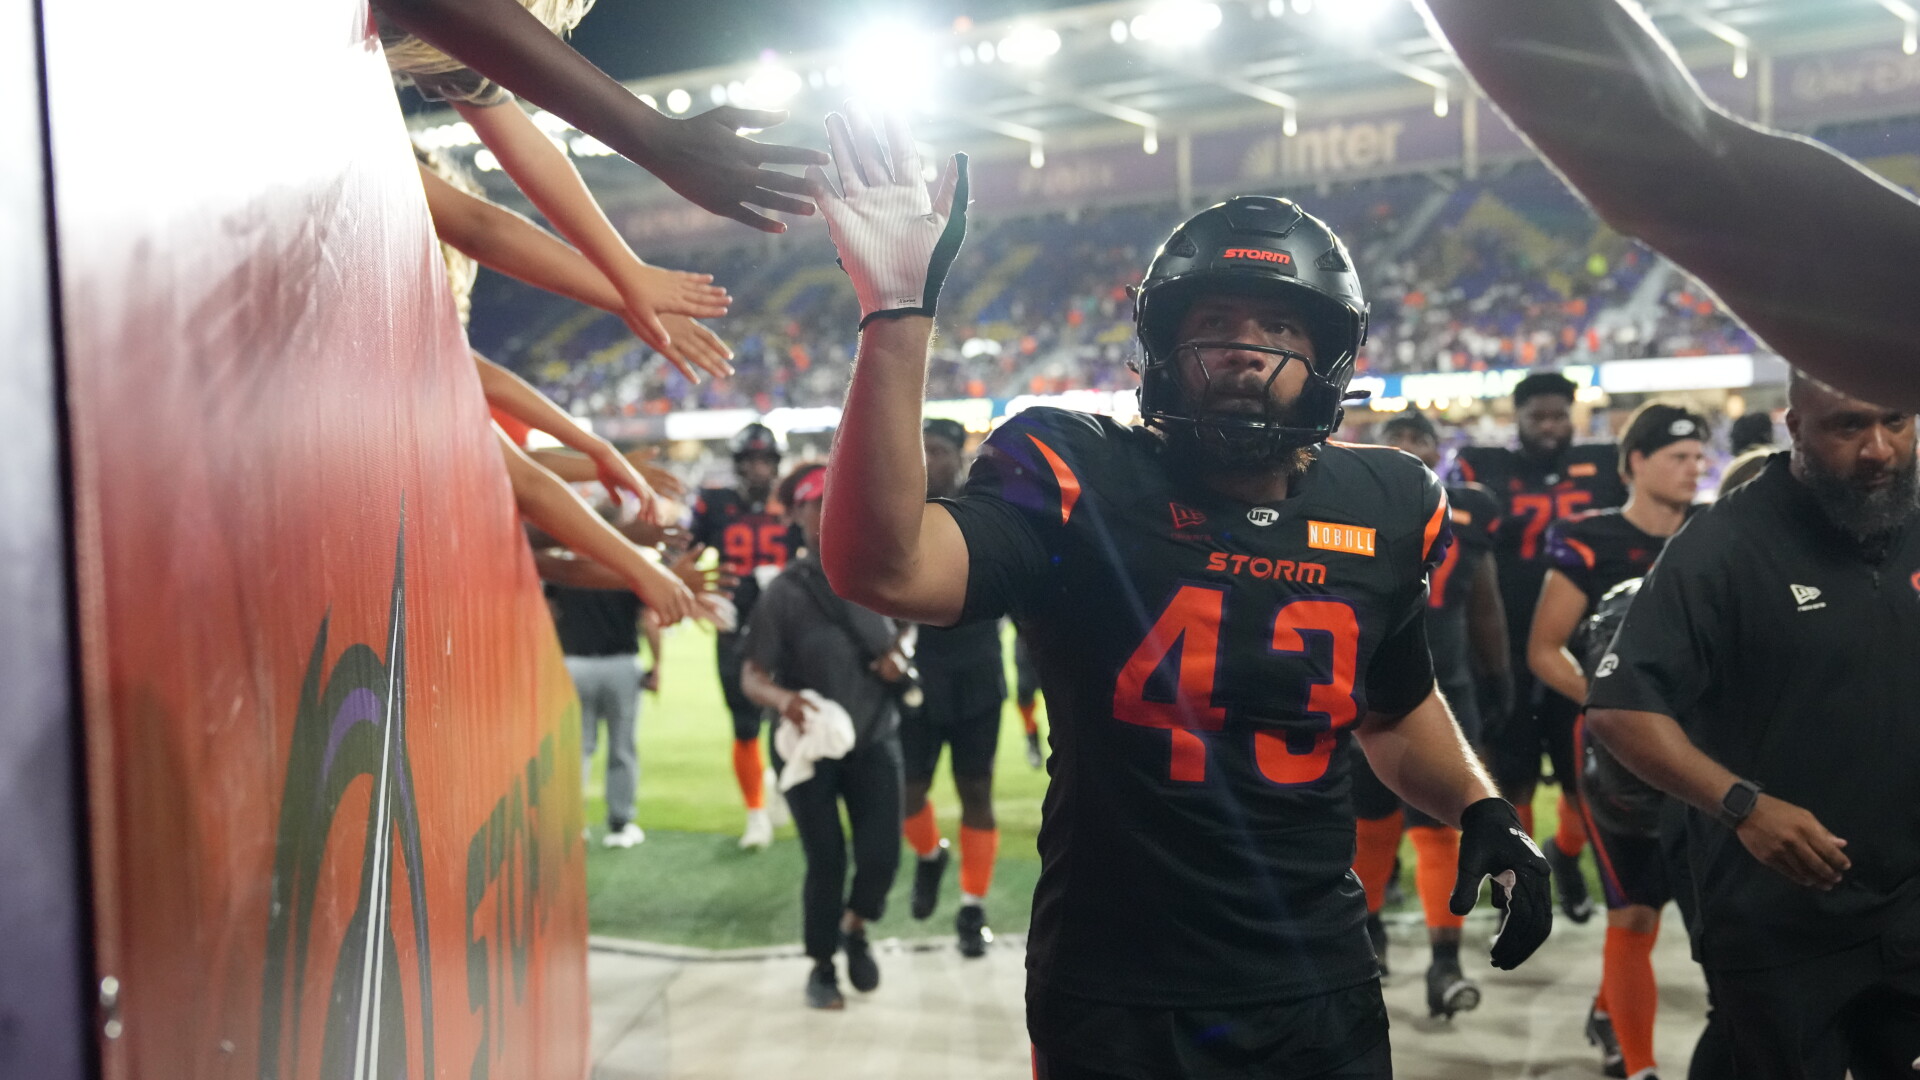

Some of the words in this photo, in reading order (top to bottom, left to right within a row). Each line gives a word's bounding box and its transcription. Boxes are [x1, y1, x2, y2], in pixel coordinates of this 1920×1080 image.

[1223, 248, 1291, 265] STORM
[1249, 509, 1276, 524] UFL
[723, 521, 789, 577] 95
[1309, 524, 1374, 551] NOBULL
[1205, 551, 1328, 585] STORM
[1112, 584, 1360, 784] 43
